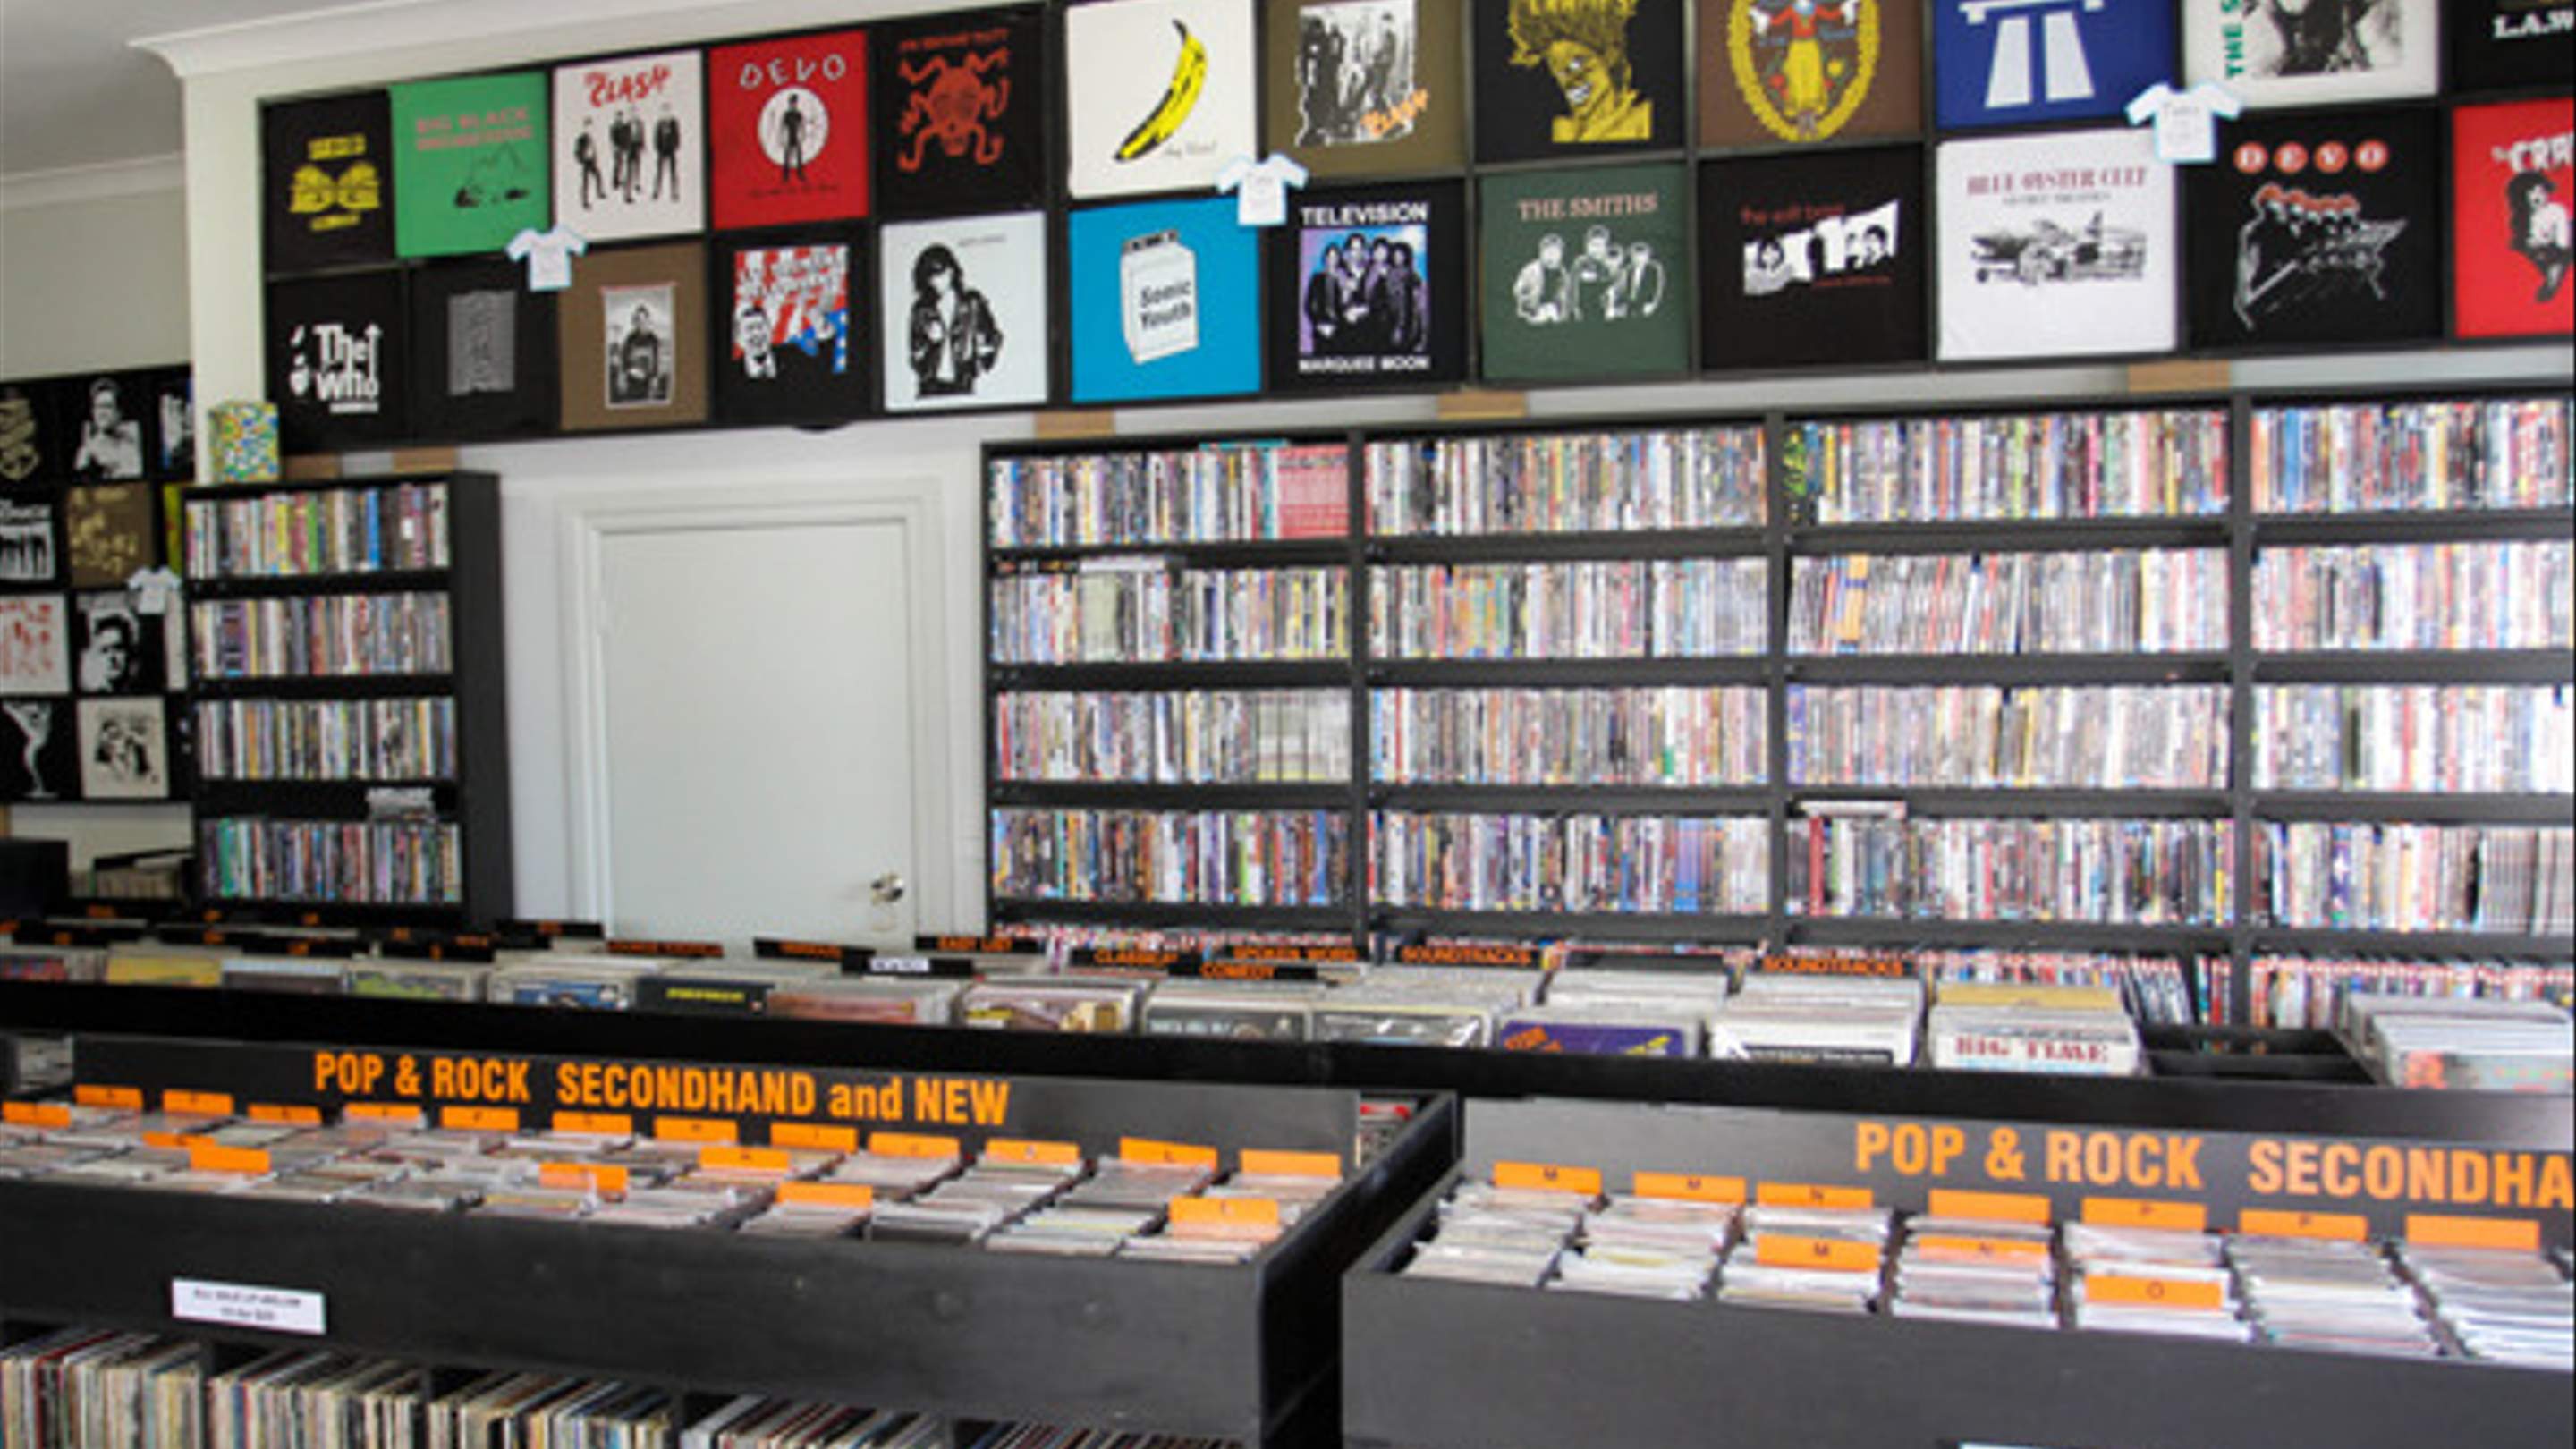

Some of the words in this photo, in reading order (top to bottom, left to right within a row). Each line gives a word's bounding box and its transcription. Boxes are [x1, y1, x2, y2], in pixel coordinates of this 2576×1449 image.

[740, 53, 846, 90] DEVO
[2240, 143, 2385, 170] DEVO
[1300, 202, 1429, 227] TELEVISION
[1519, 199, 1566, 221] THE
[1570, 193, 1658, 217] SMITHS
[1141, 280, 1191, 309] Sonic
[1140, 301, 1191, 331] Youth
[312, 324, 368, 372] The
[1299, 356, 1375, 374] MARQUEE
[1380, 353, 1430, 371] MOON
[315, 370, 380, 402] Who
[1307, 946, 1358, 962] WORD
[1401, 946, 1532, 965] SOUNDTRACKS
[1763, 956, 1903, 977] SOUNDTRACKS
[1955, 1038, 2011, 1061] BIG
[2027, 1039, 2109, 1063] TIME
[315, 1051, 385, 1093] POP
[394, 1055, 423, 1097] &
[433, 1057, 532, 1102] ROCK
[556, 1061, 817, 1117] SECONDHAND
[827, 1078, 902, 1121] and
[914, 1078, 1012, 1126] NEW
[1855, 1122, 1965, 1175] POP
[1985, 1125, 2025, 1182] &
[2046, 1131, 2205, 1189] ROCK
[2248, 1140, 2574, 1210] SECONDHA
[2145, 1280, 2166, 1301] O
